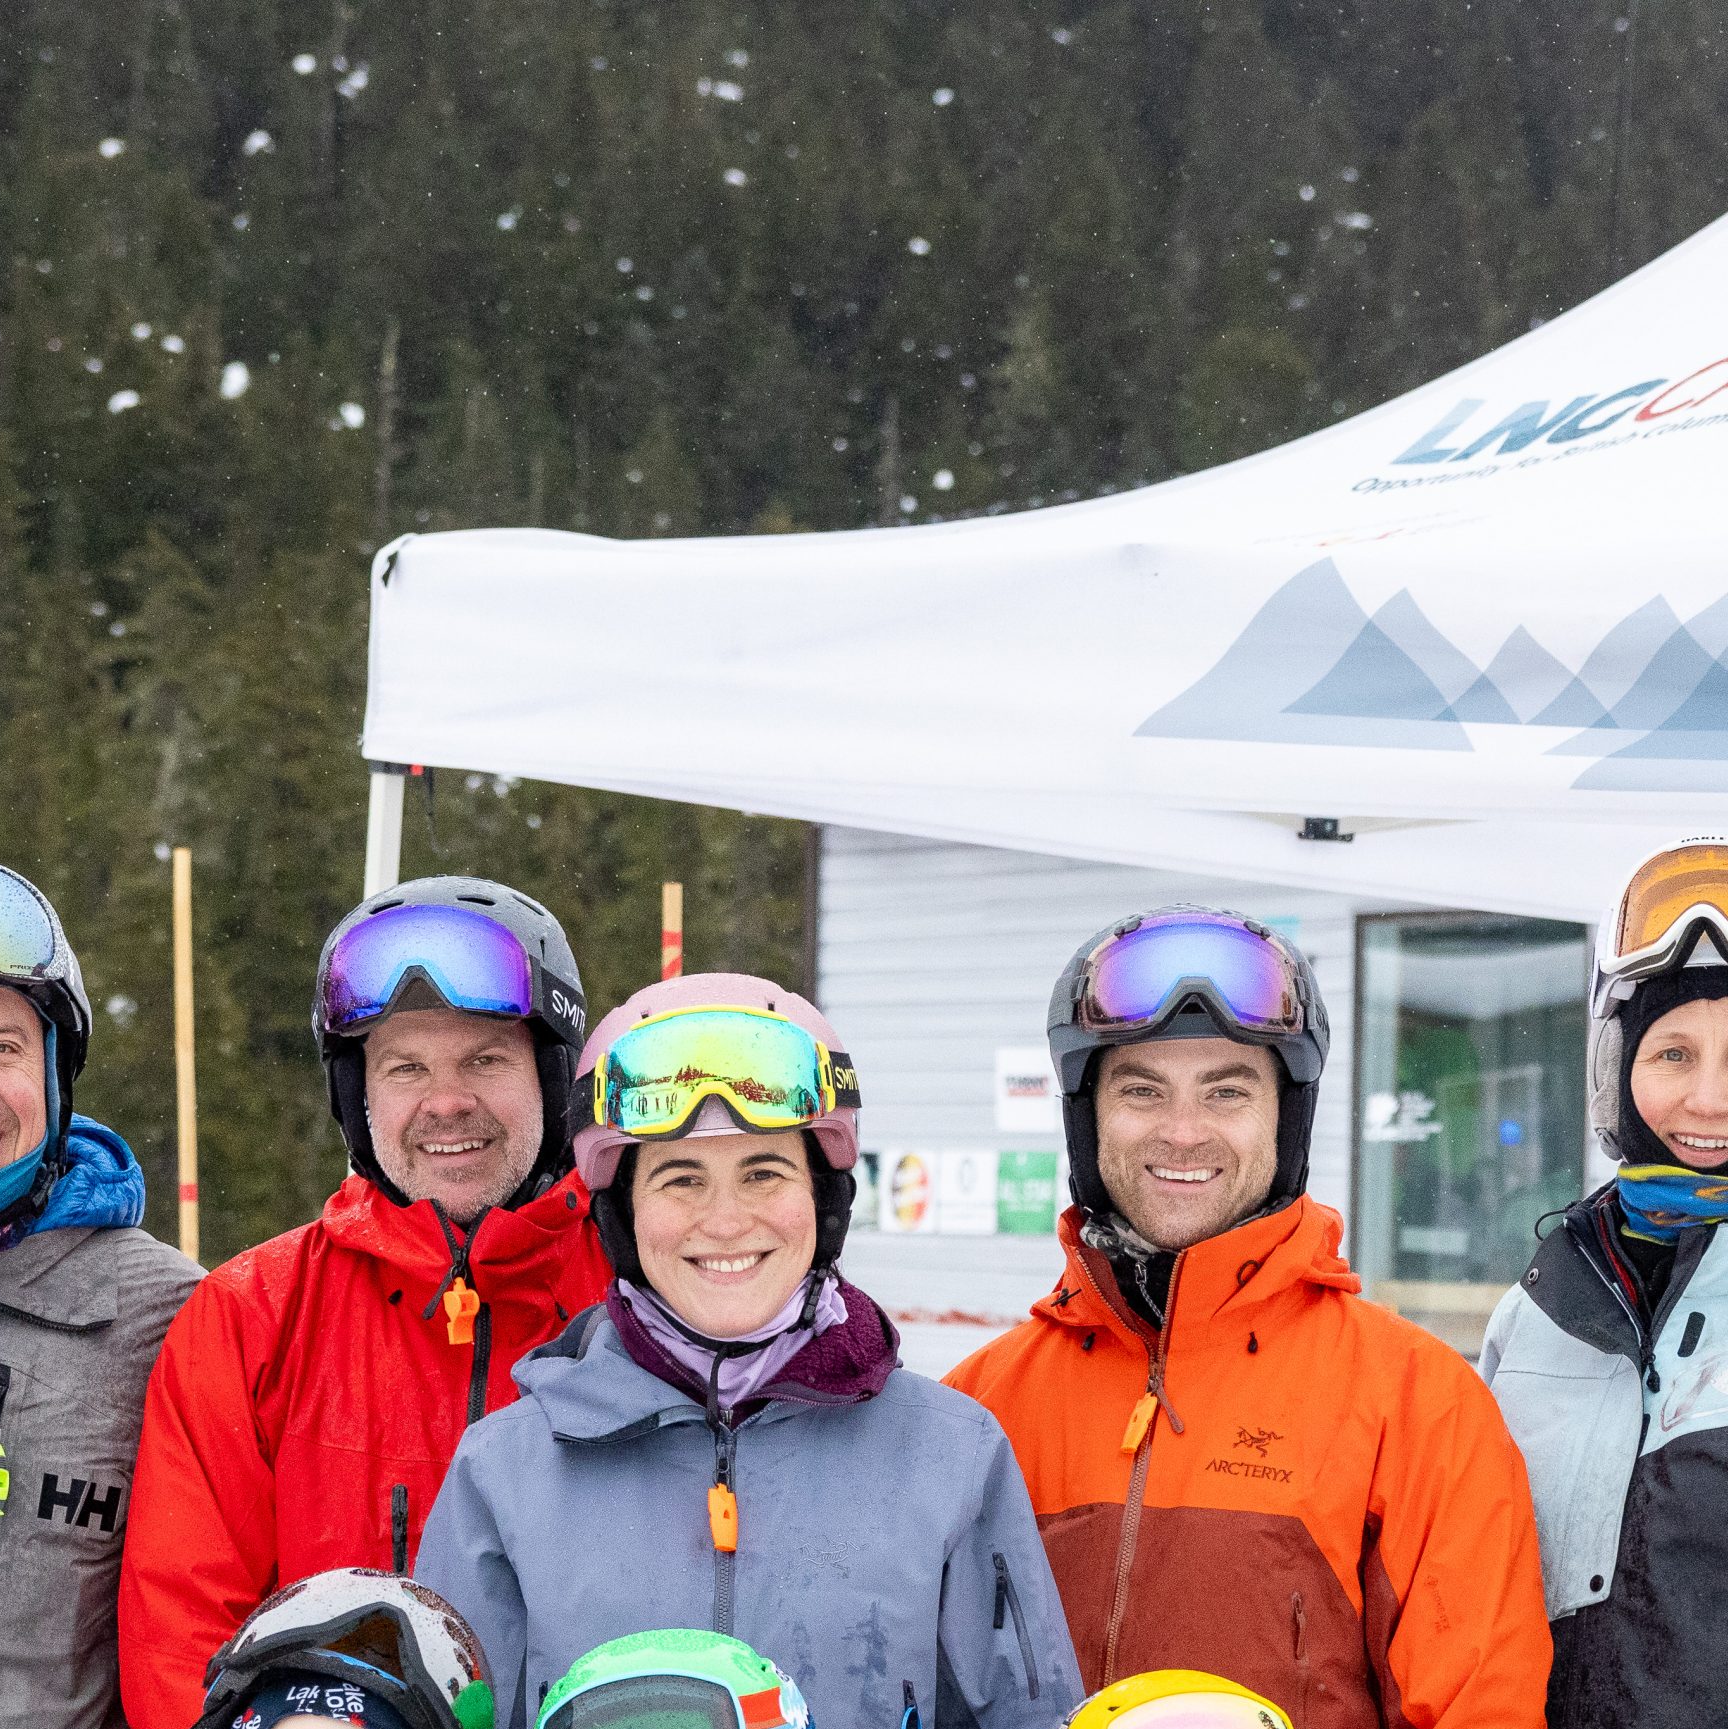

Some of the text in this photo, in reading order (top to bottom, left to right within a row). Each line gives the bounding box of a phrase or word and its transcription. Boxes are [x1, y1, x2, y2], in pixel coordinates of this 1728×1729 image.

[1351, 462, 1502, 495] Opportunity
[552, 988, 585, 1034] SMIT
[834, 1065, 859, 1091] SMIT
[36, 1472, 123, 1533] HH
[286, 1685, 321, 1701] Lak
[342, 1682, 365, 1714] ake
